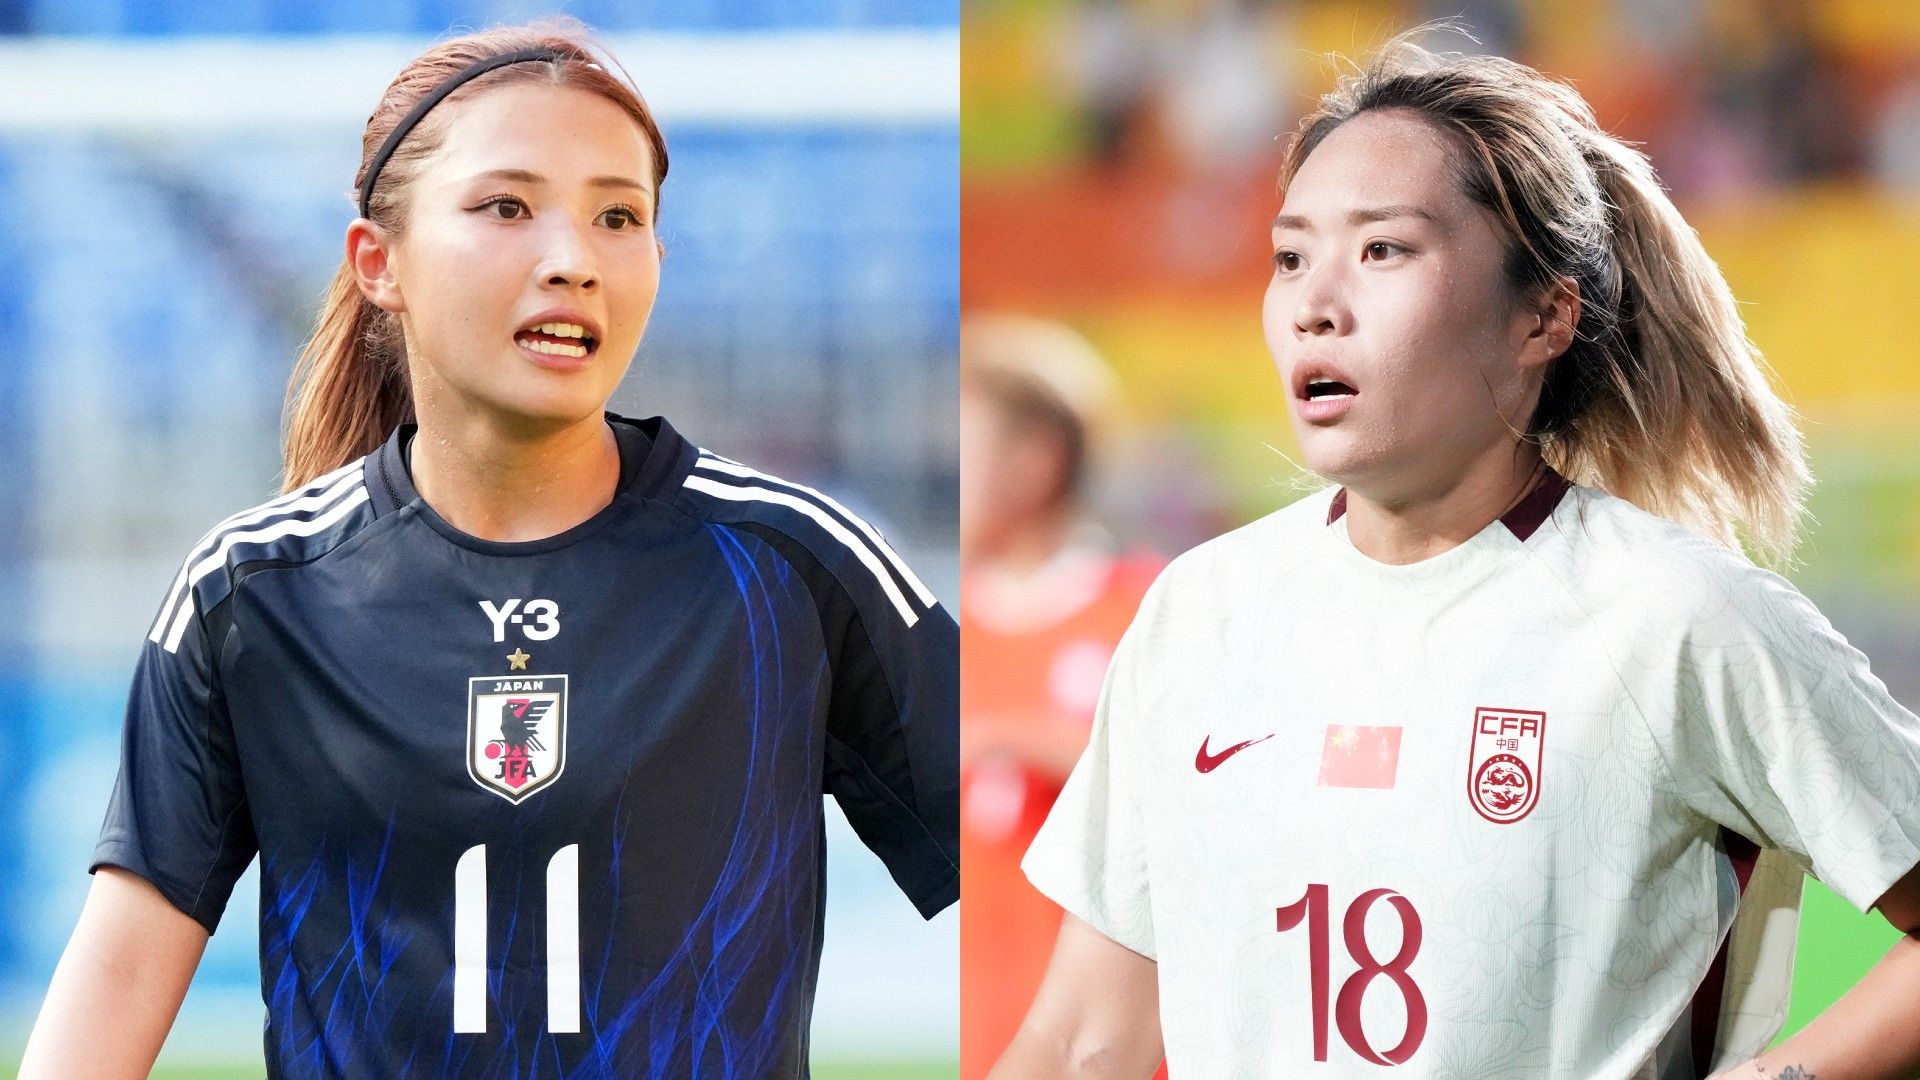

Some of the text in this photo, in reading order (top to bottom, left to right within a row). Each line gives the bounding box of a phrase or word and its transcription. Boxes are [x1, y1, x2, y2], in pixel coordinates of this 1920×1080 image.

[478, 599, 561, 642] Y-3
[493, 680, 544, 692] JAPAN
[1480, 715, 1539, 738] CFA
[1496, 738, 1519, 751] 中国
[494, 760, 537, 779] JFA
[454, 843, 580, 1033] 11
[1276, 883, 1428, 1067] 18
